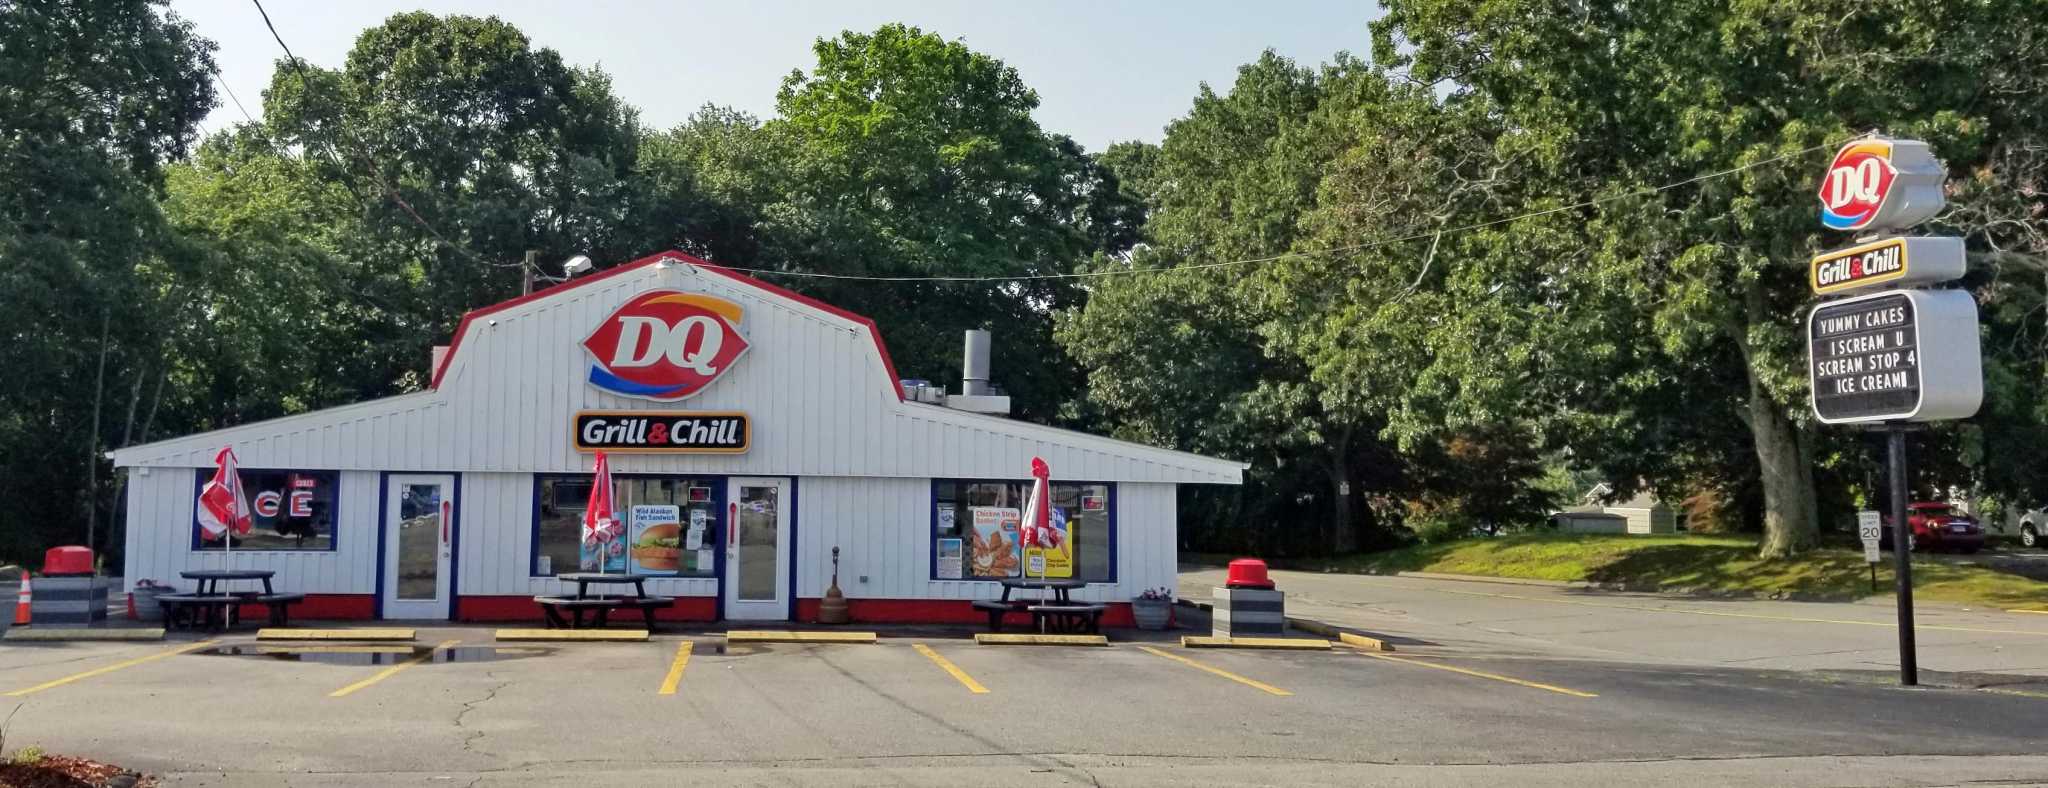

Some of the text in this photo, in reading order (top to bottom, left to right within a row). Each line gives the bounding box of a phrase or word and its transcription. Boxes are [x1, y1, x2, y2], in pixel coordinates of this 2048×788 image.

[1830, 157, 1881, 209] DQ
[1820, 306, 1905, 334] YUMMY CAKES
[610, 316, 724, 376] DQ
[1831, 331, 1904, 355] I SCREAM U
[1818, 352, 1915, 376] SCREAM STOP 4
[1837, 375, 1902, 393] ICE CREAM
[1862, 527, 1879, 538] 20
